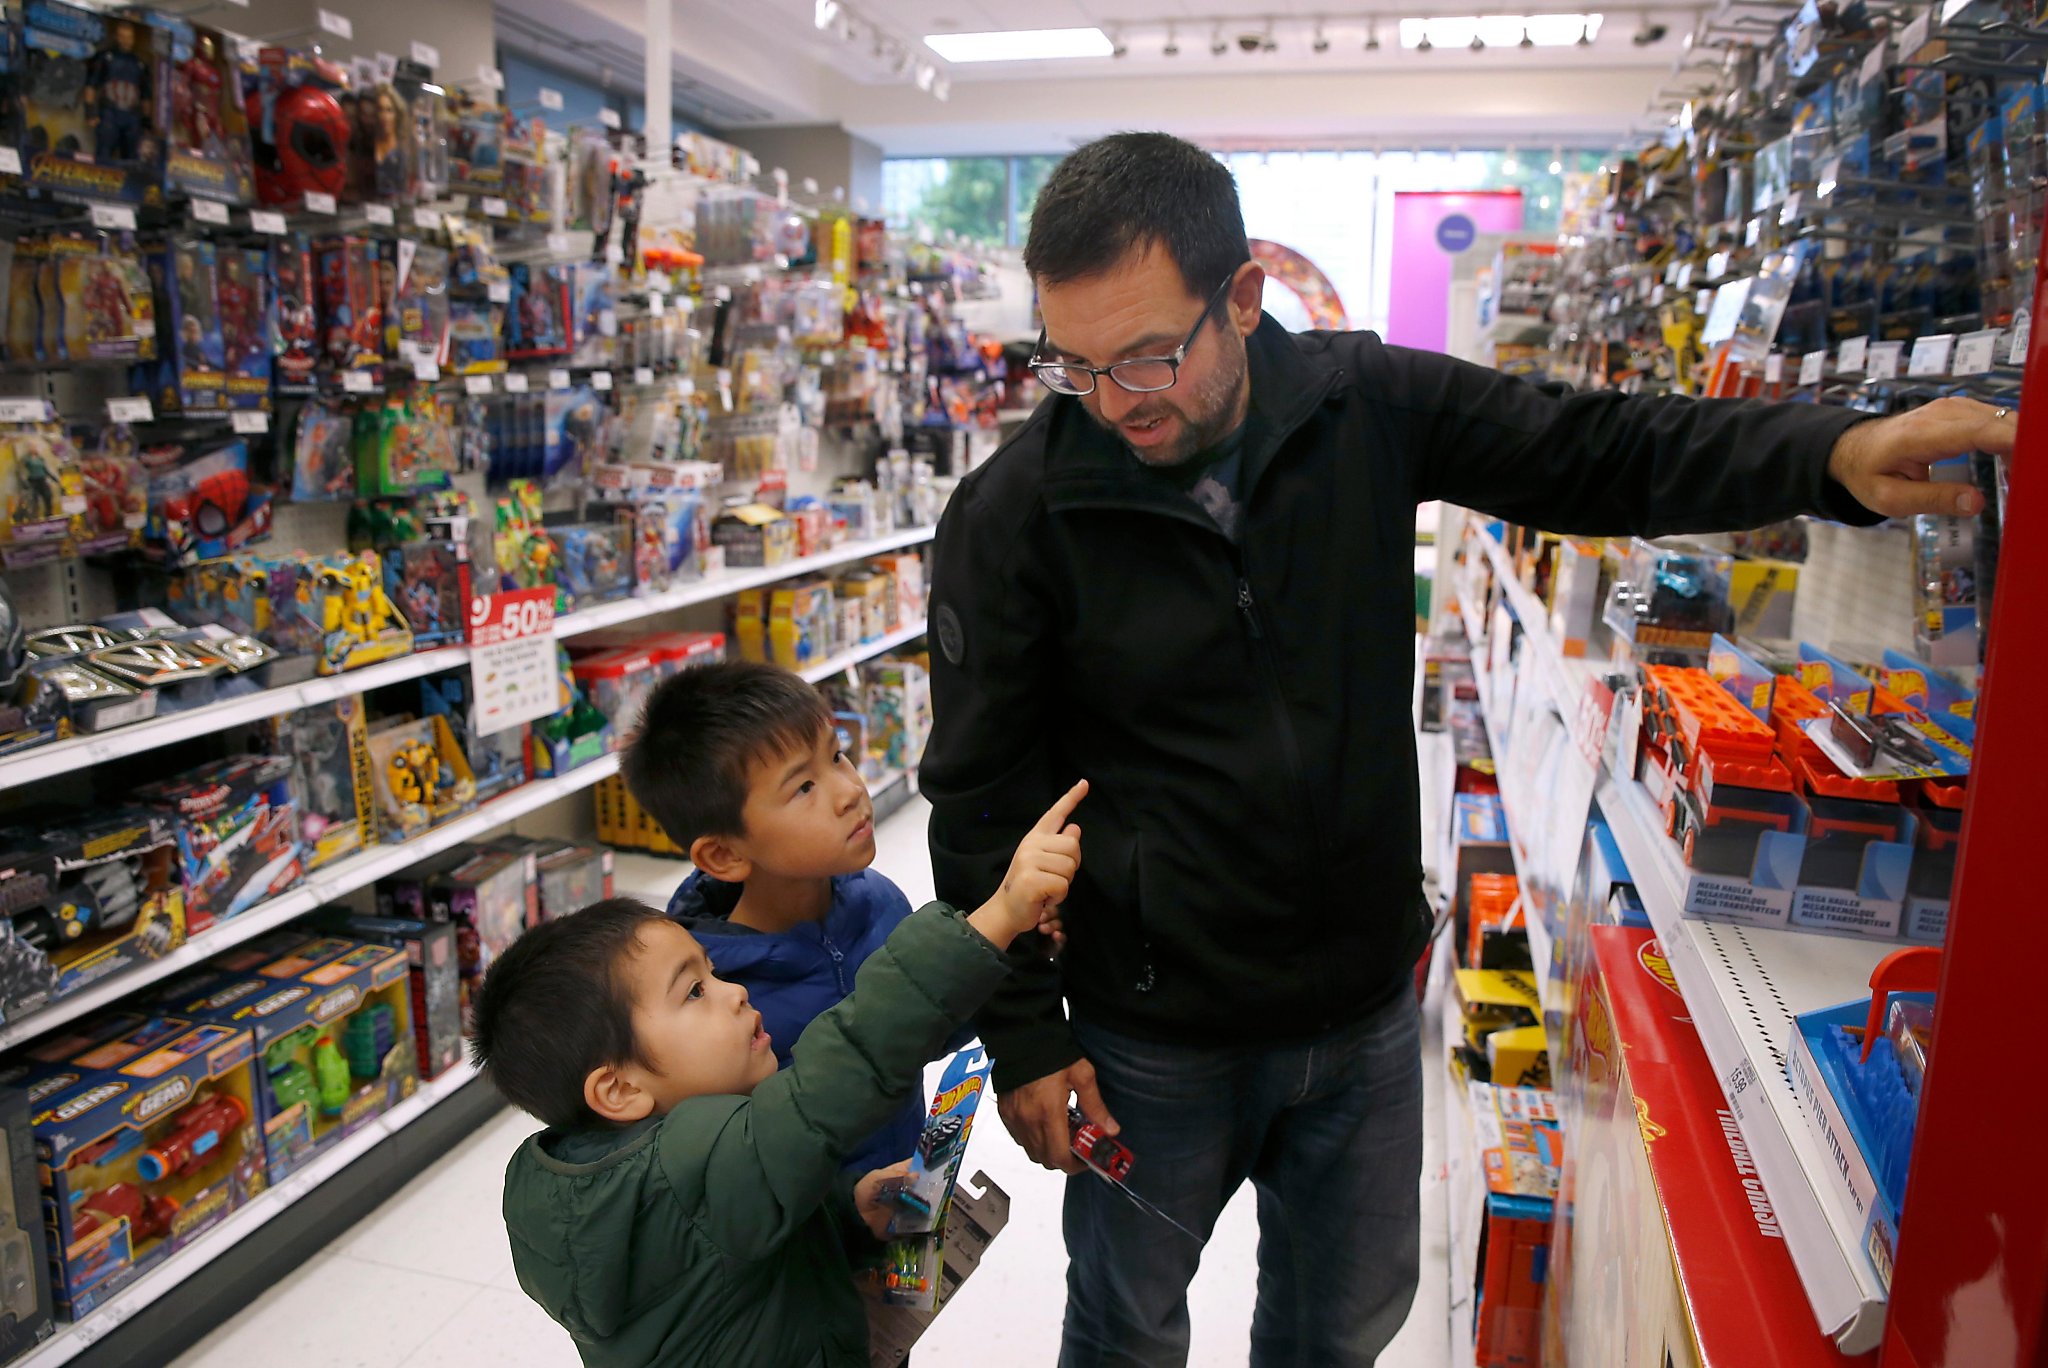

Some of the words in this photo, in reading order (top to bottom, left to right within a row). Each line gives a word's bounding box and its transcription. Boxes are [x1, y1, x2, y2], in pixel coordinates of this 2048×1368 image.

[503, 597, 556, 640] 50%
[1697, 881, 1720, 891] MEGA
[1721, 885, 1753, 896] HAULER
[1719, 900, 1782, 916] TRANSPORTEUR
[1803, 894, 1826, 903] MEGA
[1828, 897, 1860, 907] HAULER
[1826, 914, 1892, 928] TRANSPORTEUR
[1731, 1067, 1747, 1094] 15.99
[140, 1080, 186, 1117] GEAR
[1792, 1050, 1815, 1107] OCTOPUS
[1812, 1097, 1827, 1134] PIER
[1825, 1126, 1850, 1181] ATTACK
